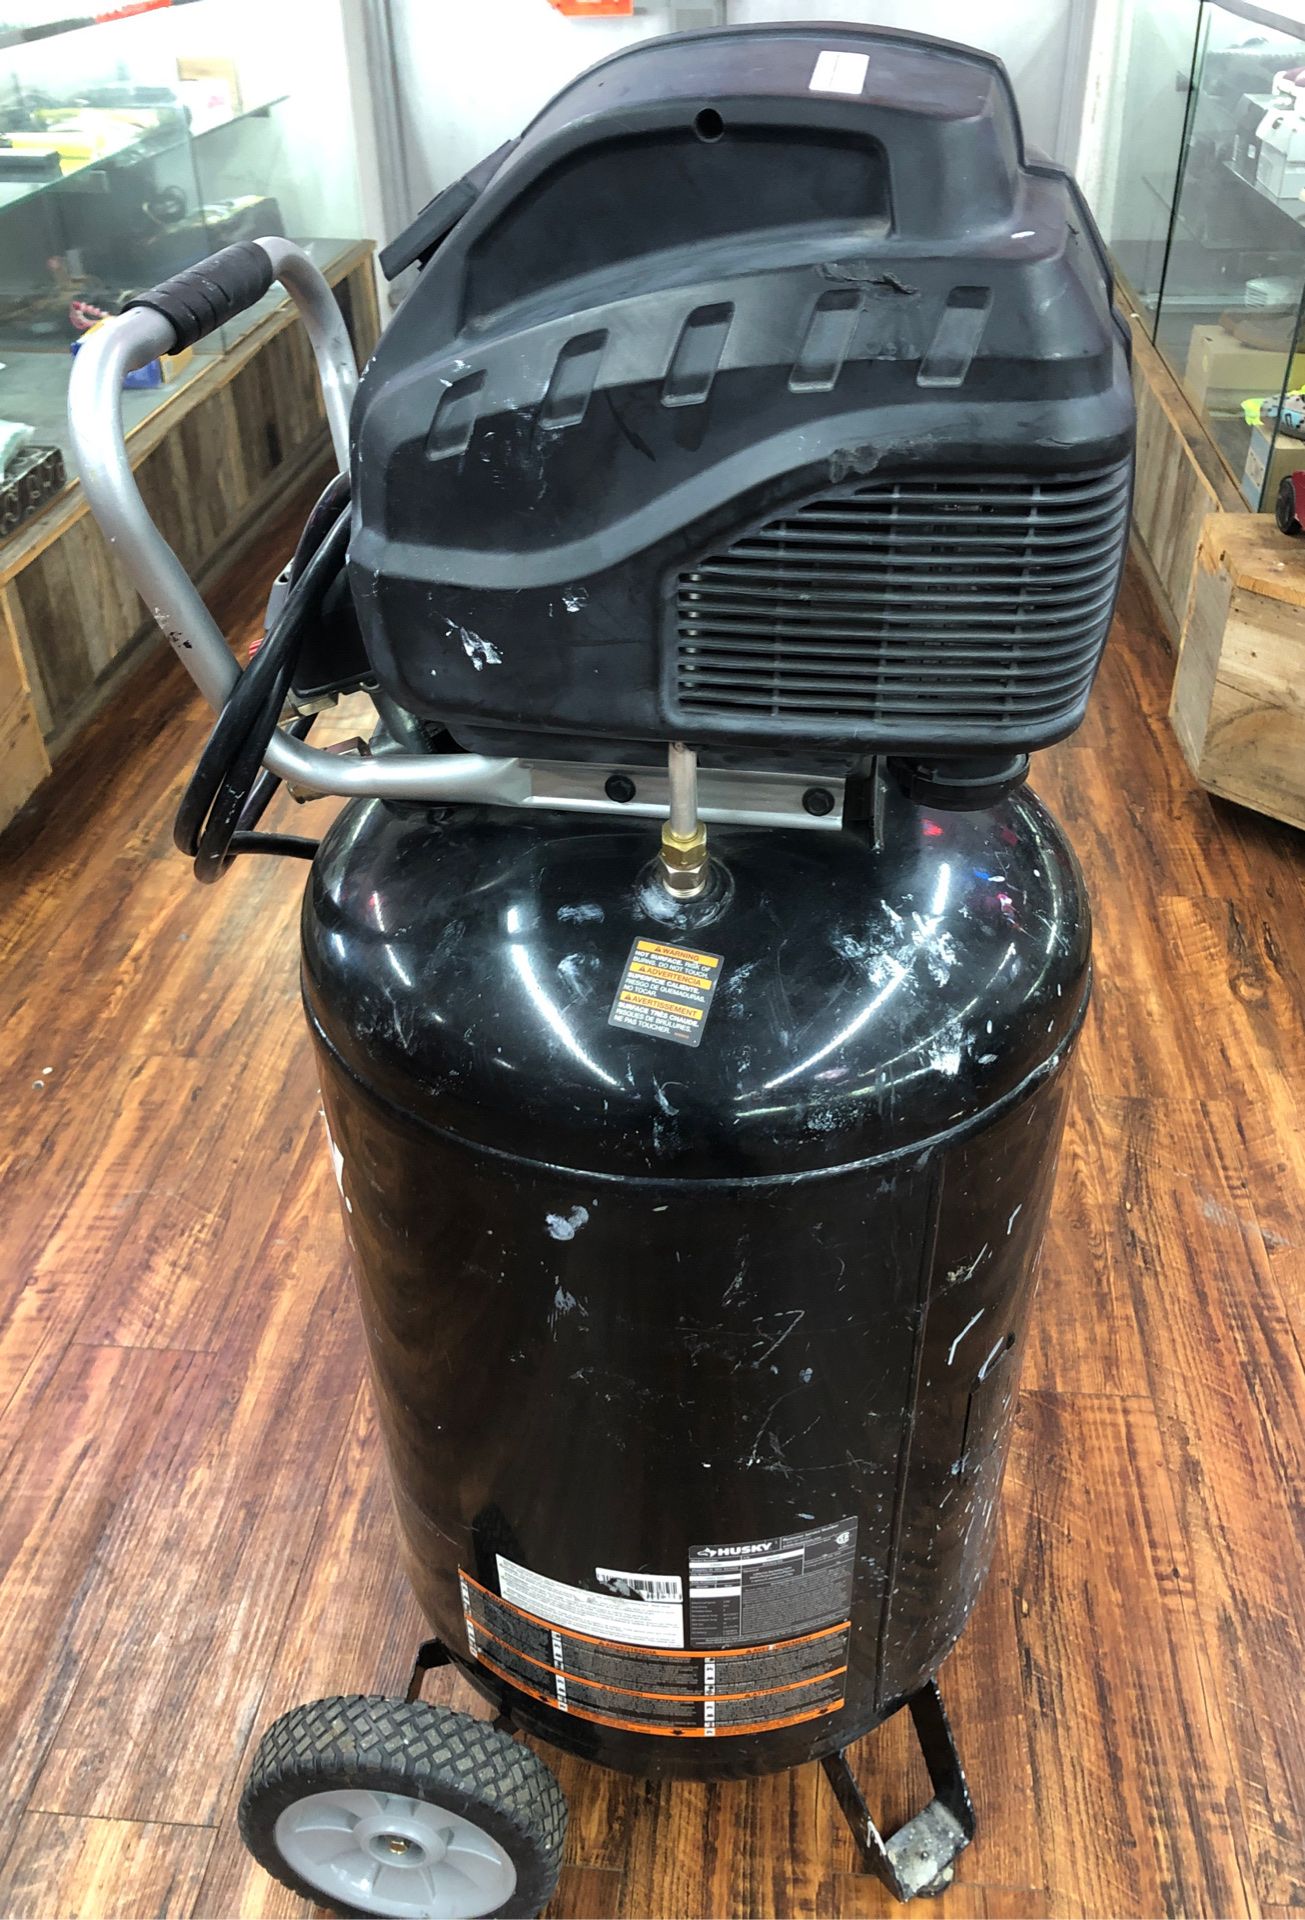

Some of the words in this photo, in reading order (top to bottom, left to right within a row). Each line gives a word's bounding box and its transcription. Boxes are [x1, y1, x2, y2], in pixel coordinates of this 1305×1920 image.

[662, 948, 700, 961] WARNING
[669, 964, 684, 972] NOT
[646, 967, 701, 986] ADVERTENCIA
[632, 995, 697, 1017] AVERTISSEMENT
[624, 1016, 638, 1026] PAS
[717, 1542, 773, 1556] HUSKY
